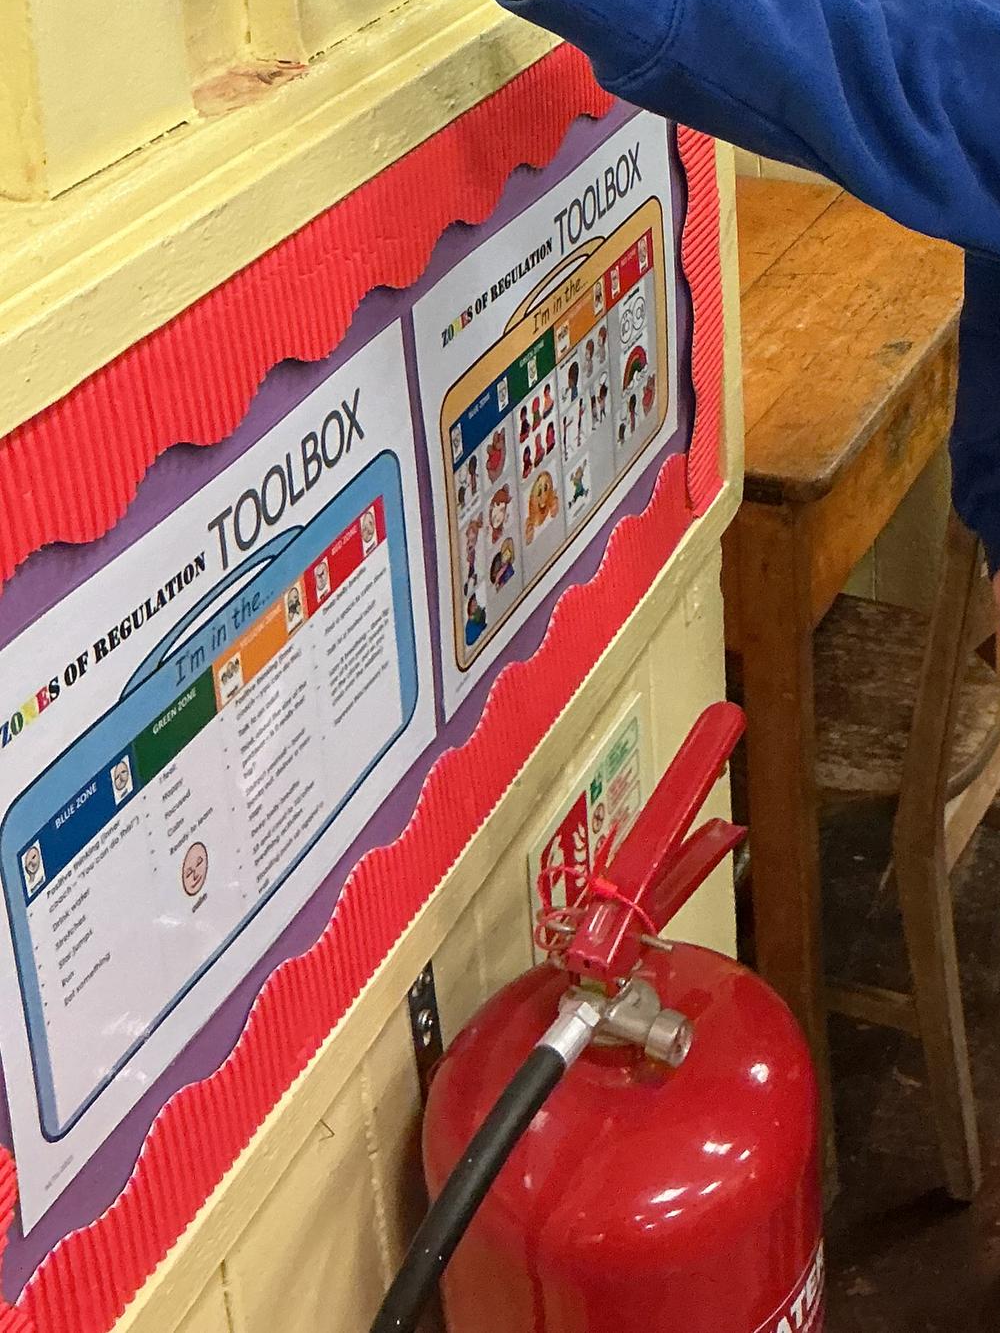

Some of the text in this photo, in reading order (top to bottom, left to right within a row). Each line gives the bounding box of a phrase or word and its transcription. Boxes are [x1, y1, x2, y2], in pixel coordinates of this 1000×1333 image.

[475, 288, 488, 316] OF
[491, 237, 553, 302] REGULATION
[554, 142, 642, 255] TOOLBOX
[533, 307, 550, 334] I'm
[553, 296, 562, 314] in
[64, 650, 88, 687] OF
[93, 551, 206, 665] REGULATION
[208, 388, 365, 571] TOOLBOX
[176, 647, 205, 686] I'm
[211, 624, 227, 650] in
[152, 687, 197, 735] GREEN ZONE
[54, 782, 97, 830] BLUE ZONE
[164, 786, 190, 822] Focused
[46, 866, 72, 900] Positive
[73, 838, 99, 873] thinking
[75, 948, 110, 996] something
